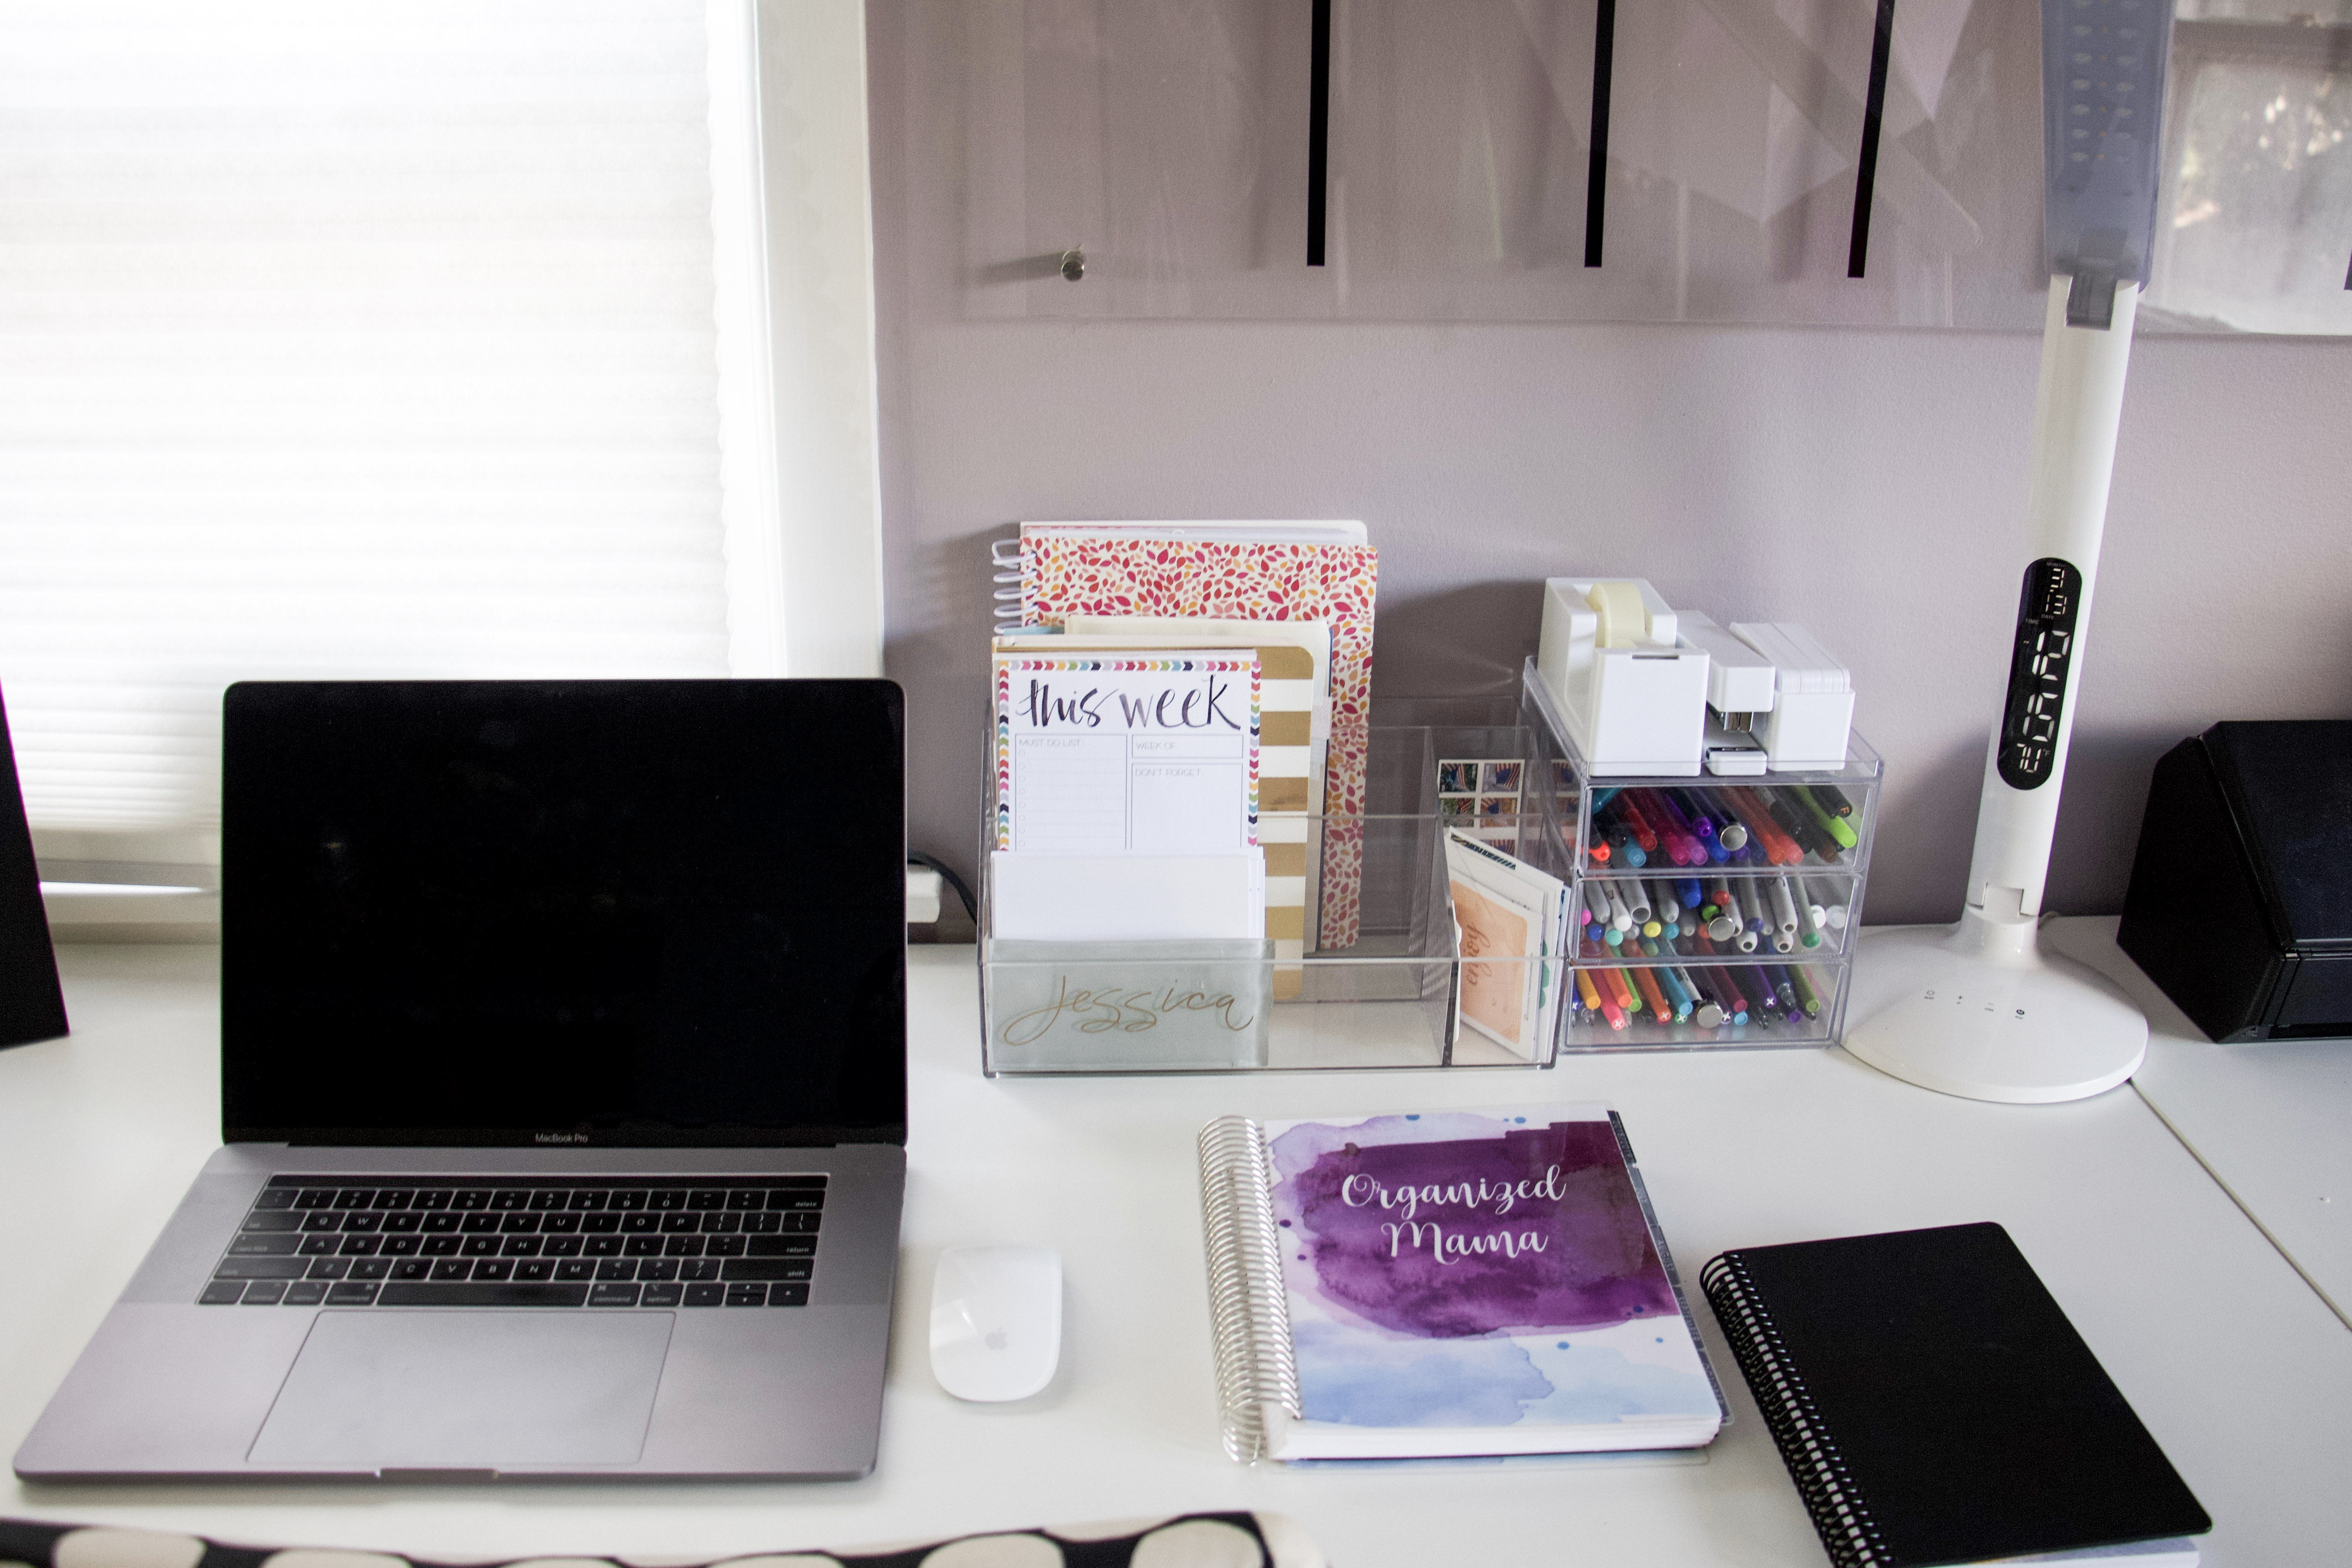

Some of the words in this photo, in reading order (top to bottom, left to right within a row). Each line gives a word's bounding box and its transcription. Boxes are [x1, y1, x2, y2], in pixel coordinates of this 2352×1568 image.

[2051, 568, 2065, 588] 3
[2045, 594, 2067, 615] 13
[2031, 630, 2070, 681] 12
[1015, 678, 1119, 728] this
[1119, 674, 1241, 730] week
[2022, 692, 2059, 742] 15
[1019, 739, 1044, 747] MUST
[1047, 739, 1061, 747] DO
[1135, 768, 1163, 776] DON'T
[1464, 922, 1491, 986] enjoy
[1003, 975, 1254, 1046] Jessica
[535, 1133, 573, 1143] MacBook
[574, 1133, 588, 1143] Pro
[1342, 1164, 1566, 1220] Organized
[1381, 1220, 1550, 1266] Mama
